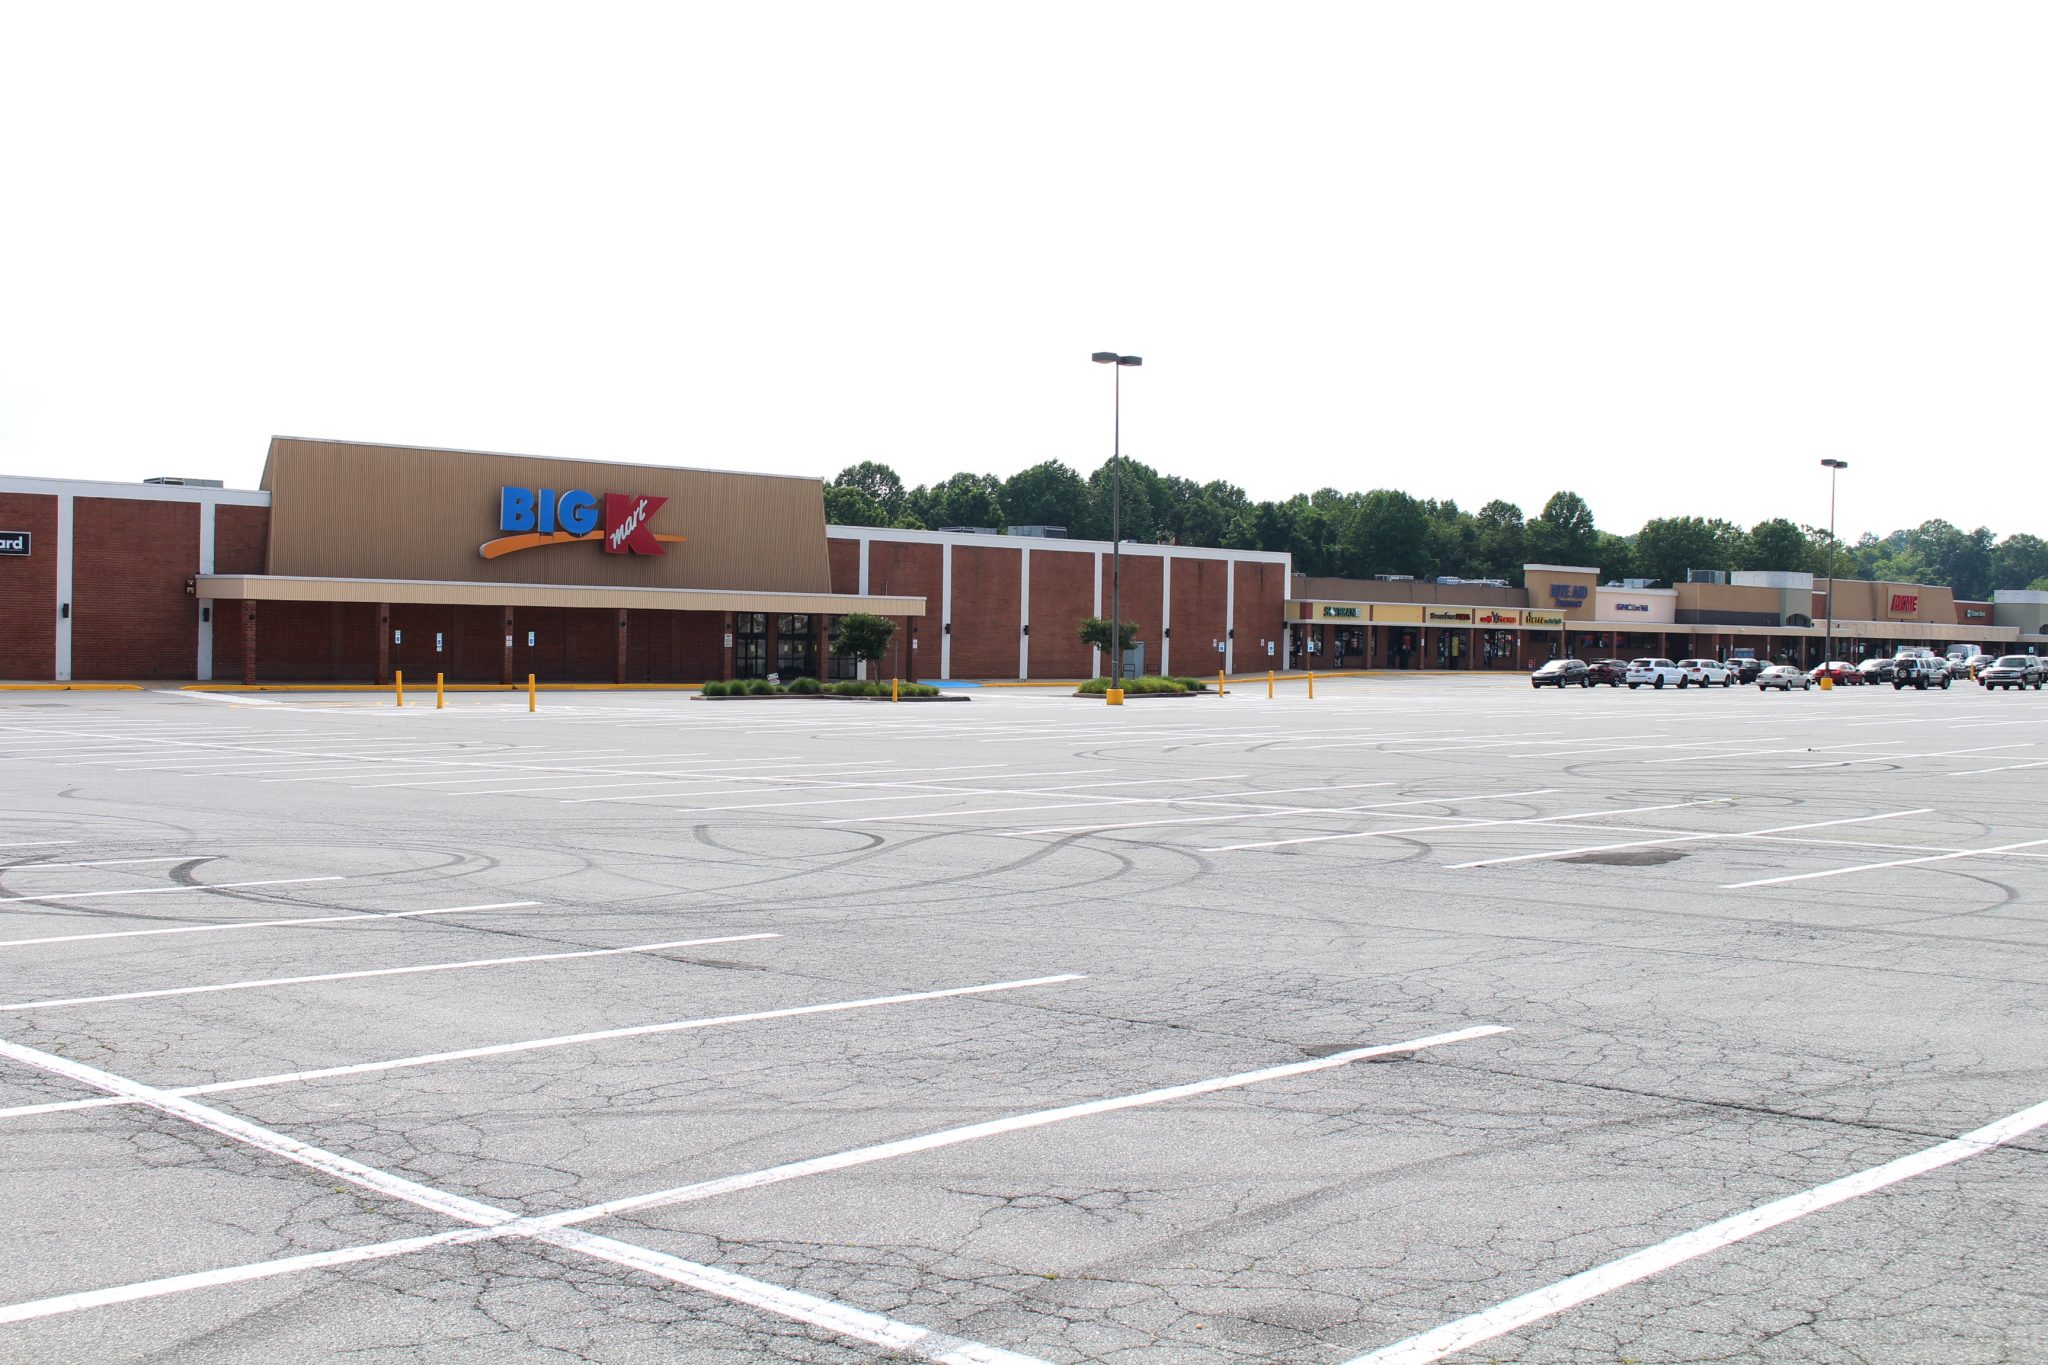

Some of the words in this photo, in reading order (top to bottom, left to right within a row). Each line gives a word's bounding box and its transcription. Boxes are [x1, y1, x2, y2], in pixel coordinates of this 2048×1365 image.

[500, 486, 599, 534] BIG
[603, 492, 669, 556] K
[610, 499, 648, 550] mart
[1891, 594, 1918, 612] ACME
